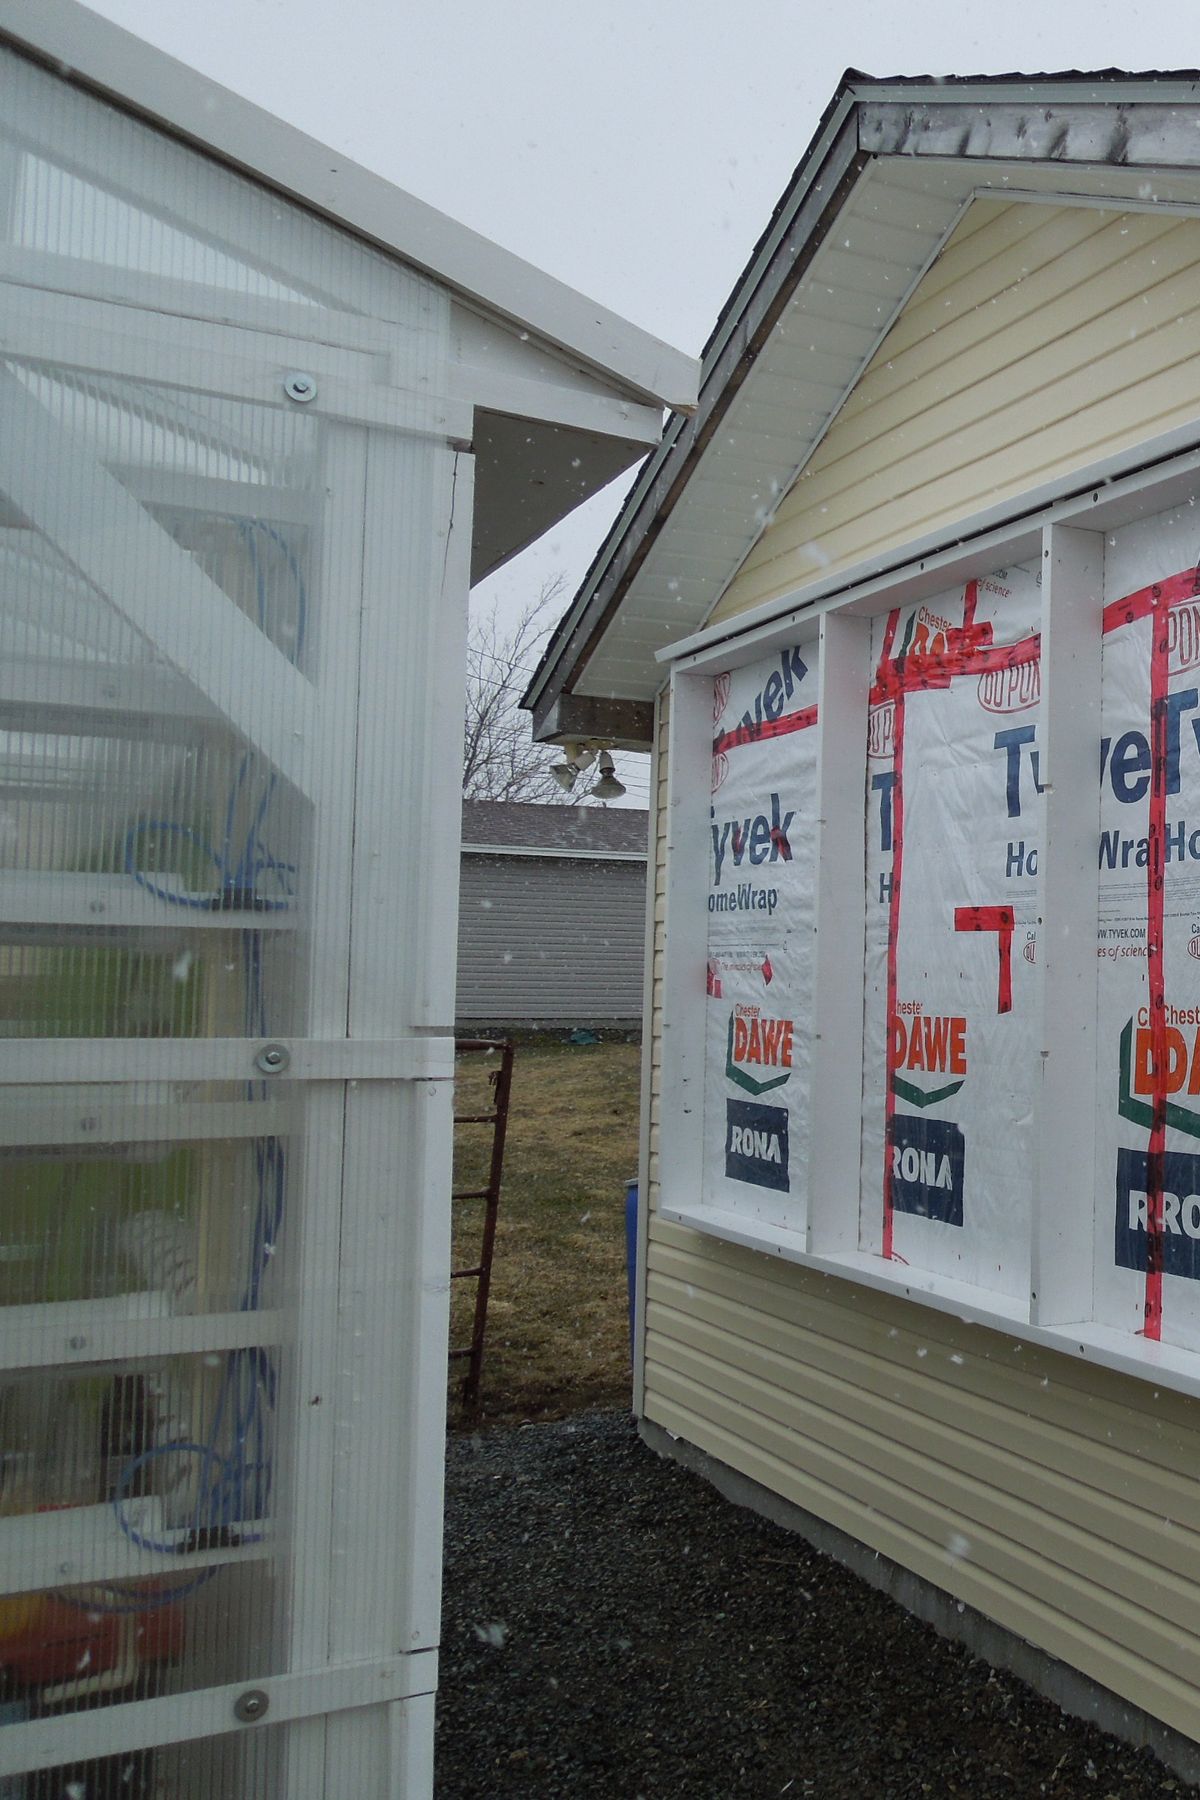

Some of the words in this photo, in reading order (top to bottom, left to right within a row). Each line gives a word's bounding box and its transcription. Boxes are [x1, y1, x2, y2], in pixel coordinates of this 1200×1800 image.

[711, 792, 795, 887] yvek
[707, 882, 778, 916] omeWrap
[1026, 931, 1037, 941] Cal
[1108, 945, 1120, 961] of
[1120, 944, 1152, 957] scienc
[733, 1017, 794, 1068] DAWE
[893, 1015, 967, 1076] DAWE
[730, 1125, 782, 1164] RONA
[892, 1147, 953, 1191] RONA
